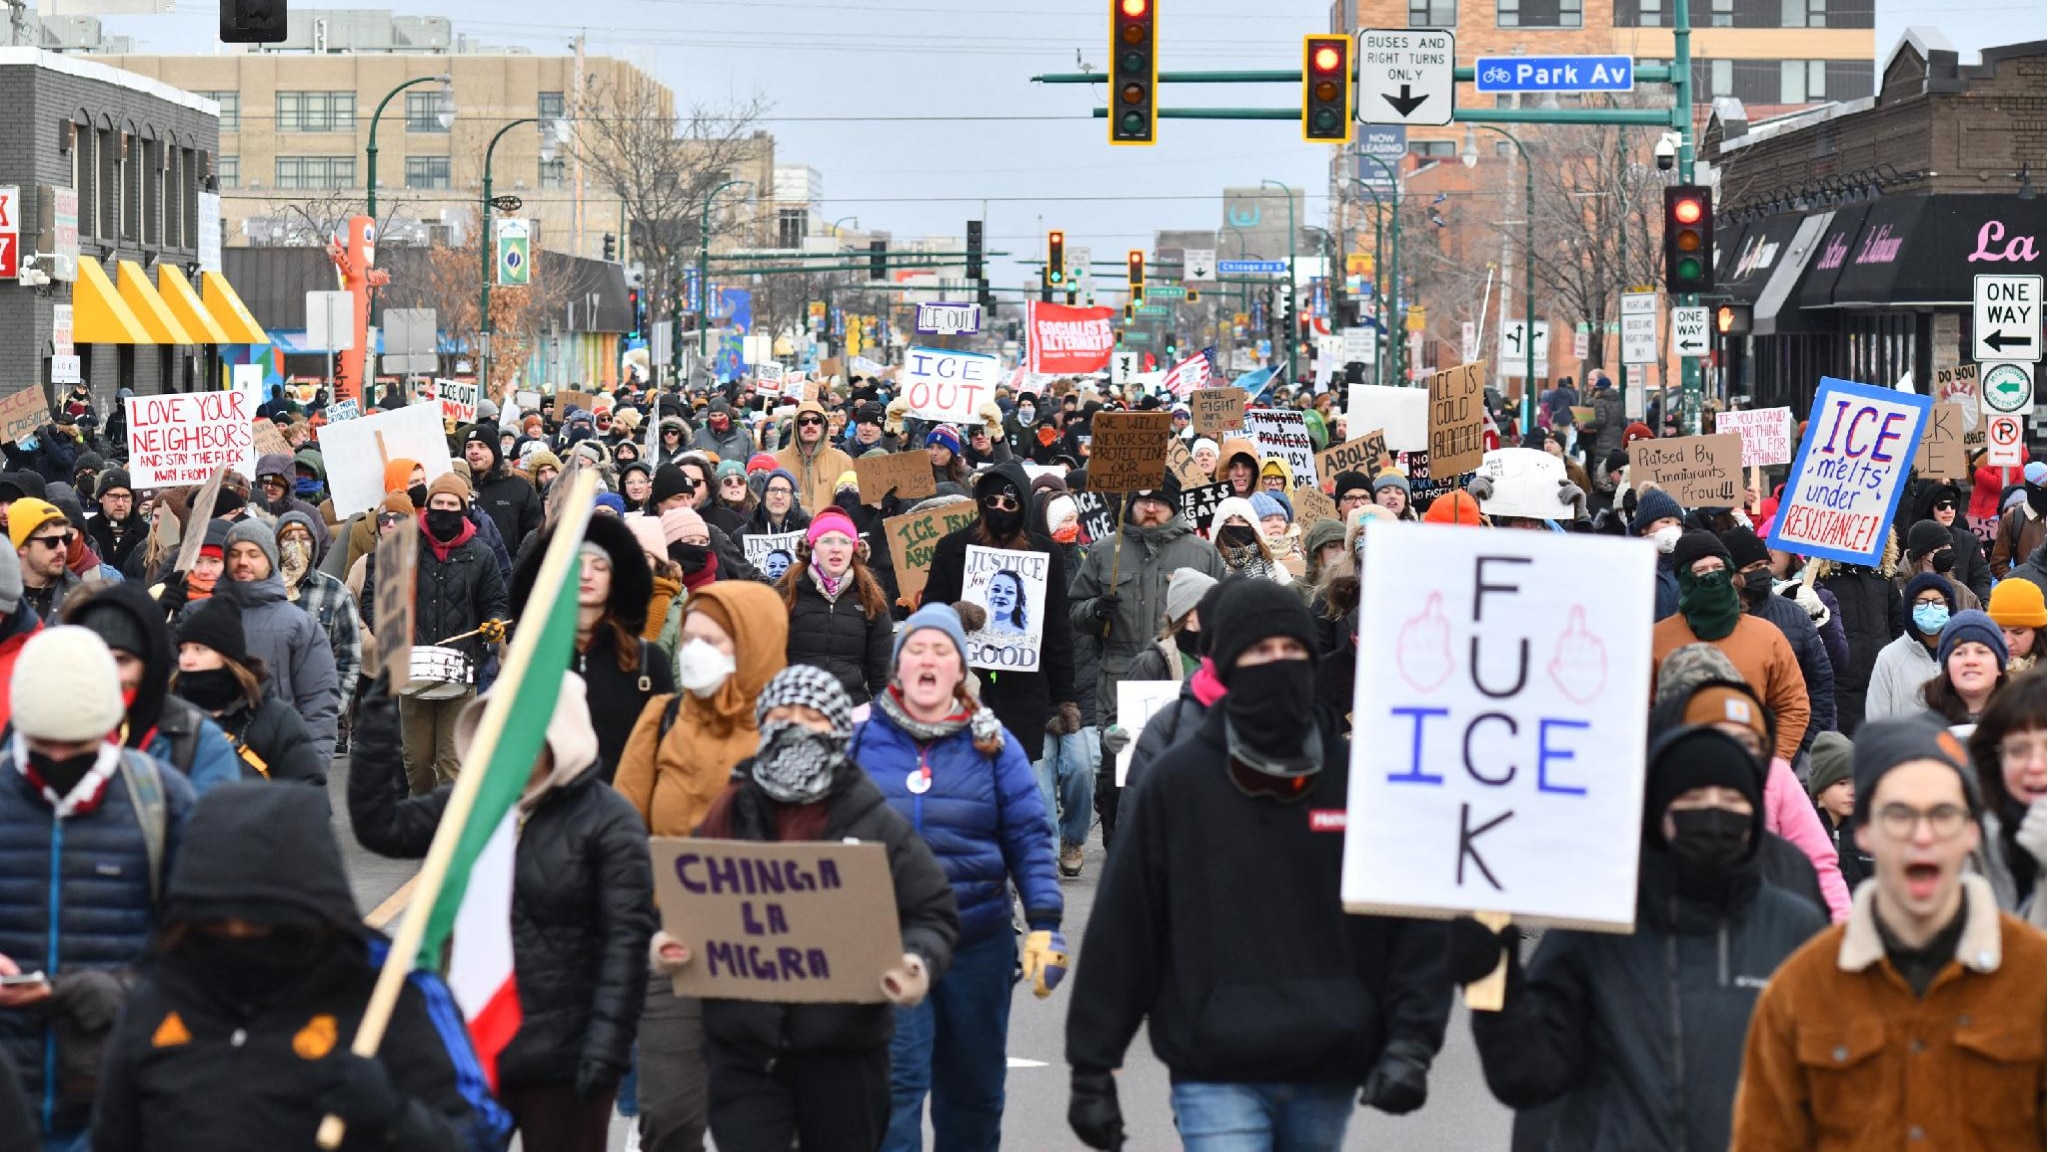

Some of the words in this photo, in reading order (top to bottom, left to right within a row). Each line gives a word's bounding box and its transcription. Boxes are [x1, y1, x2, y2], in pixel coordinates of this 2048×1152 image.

[1367, 37, 1409, 49] BUSES
[1418, 37, 1445, 49] AND
[1367, 53, 1405, 65] RIGHT
[1409, 53, 1445, 65] TURNS
[1388, 68, 1423, 81] ONLY
[1516, 64, 1578, 85] Park
[1590, 63, 1626, 84] Av
[1368, 133, 1396, 143] NOW
[1361, 143, 1403, 153] LEASING
[1967, 220, 2040, 262] La
[1222, 263, 1259, 272] Chicago
[1262, 263, 1273, 271] Av
[1987, 283, 2029, 301] ONE
[947, 309, 976, 331] OUT!
[1677, 311, 1704, 323] ONE
[1987, 306, 2031, 324] WAY
[1677, 325, 1703, 336] WAY
[910, 354, 984, 381] ICE
[1938, 370, 1951, 384] DO
[1954, 365, 1975, 381] YOU
[1989, 367, 2025, 383] MIDTOWN
[1432, 370, 1454, 402] ICE
[1464, 365, 1477, 395] IS
[1940, 382, 1975, 400] NAZI
[0, 387, 36, 414] ICE
[439, 382, 456, 401] ICE
[459, 386, 476, 407] OUT
[909, 382, 984, 415] OUT
[1988, 391, 2027, 407] GREENWAY
[132, 398, 186, 427] LOVE
[194, 391, 246, 422] YOUR
[441, 400, 475, 420] NOW
[1200, 399, 1236, 411] FIGHT
[1435, 396, 1469, 426] COLD
[1098, 416, 1117, 430] WE
[1128, 416, 1164, 430] WILL
[1252, 412, 1304, 425] THOUGHTS
[1717, 414, 1733, 426] IF
[1736, 412, 1754, 425] YOU
[1755, 409, 1786, 424] STAND
[132, 422, 251, 454] NEIGHBORS
[1094, 432, 1137, 446] NEVER
[1137, 432, 1168, 446] STOP
[1258, 432, 1310, 449] PRAYERS
[1433, 421, 1481, 460] BLOODED
[1821, 400, 1907, 462] ICE
[1092, 447, 1169, 461] PROTECTING
[1768, 438, 1786, 452] FOR
[140, 453, 163, 468] AND
[166, 452, 189, 466] STAY
[192, 451, 212, 464] THE
[1325, 435, 1388, 477] ABOLISH
[1412, 454, 1428, 466] NO
[1638, 447, 1684, 467] Raised
[1694, 444, 1714, 466] By
[154, 468, 177, 483] AWAY
[182, 467, 206, 481] FROM
[1111, 461, 1138, 473] OUR
[1652, 465, 1726, 487] Immigrants
[1817, 457, 1882, 490] melts
[1088, 472, 1163, 490] NEIGHBORS
[1073, 491, 1102, 514] ICE
[1201, 484, 1230, 502] IS
[1412, 491, 1423, 500] NO
[1805, 482, 1861, 510] under
[897, 515, 940, 550] ICE
[1086, 511, 1116, 541] ICE
[1782, 504, 1879, 552] RESISTANCE!
[746, 534, 803, 557] JUSTIC
[967, 551, 1045, 582] JUSTICE
[967, 571, 985, 589] for
[966, 641, 1037, 667] GOOD
[1386, 707, 1592, 797] ICE
[674, 853, 842, 895] CHINGA
[740, 901, 789, 935] LA
[705, 940, 830, 982] MIGRA
